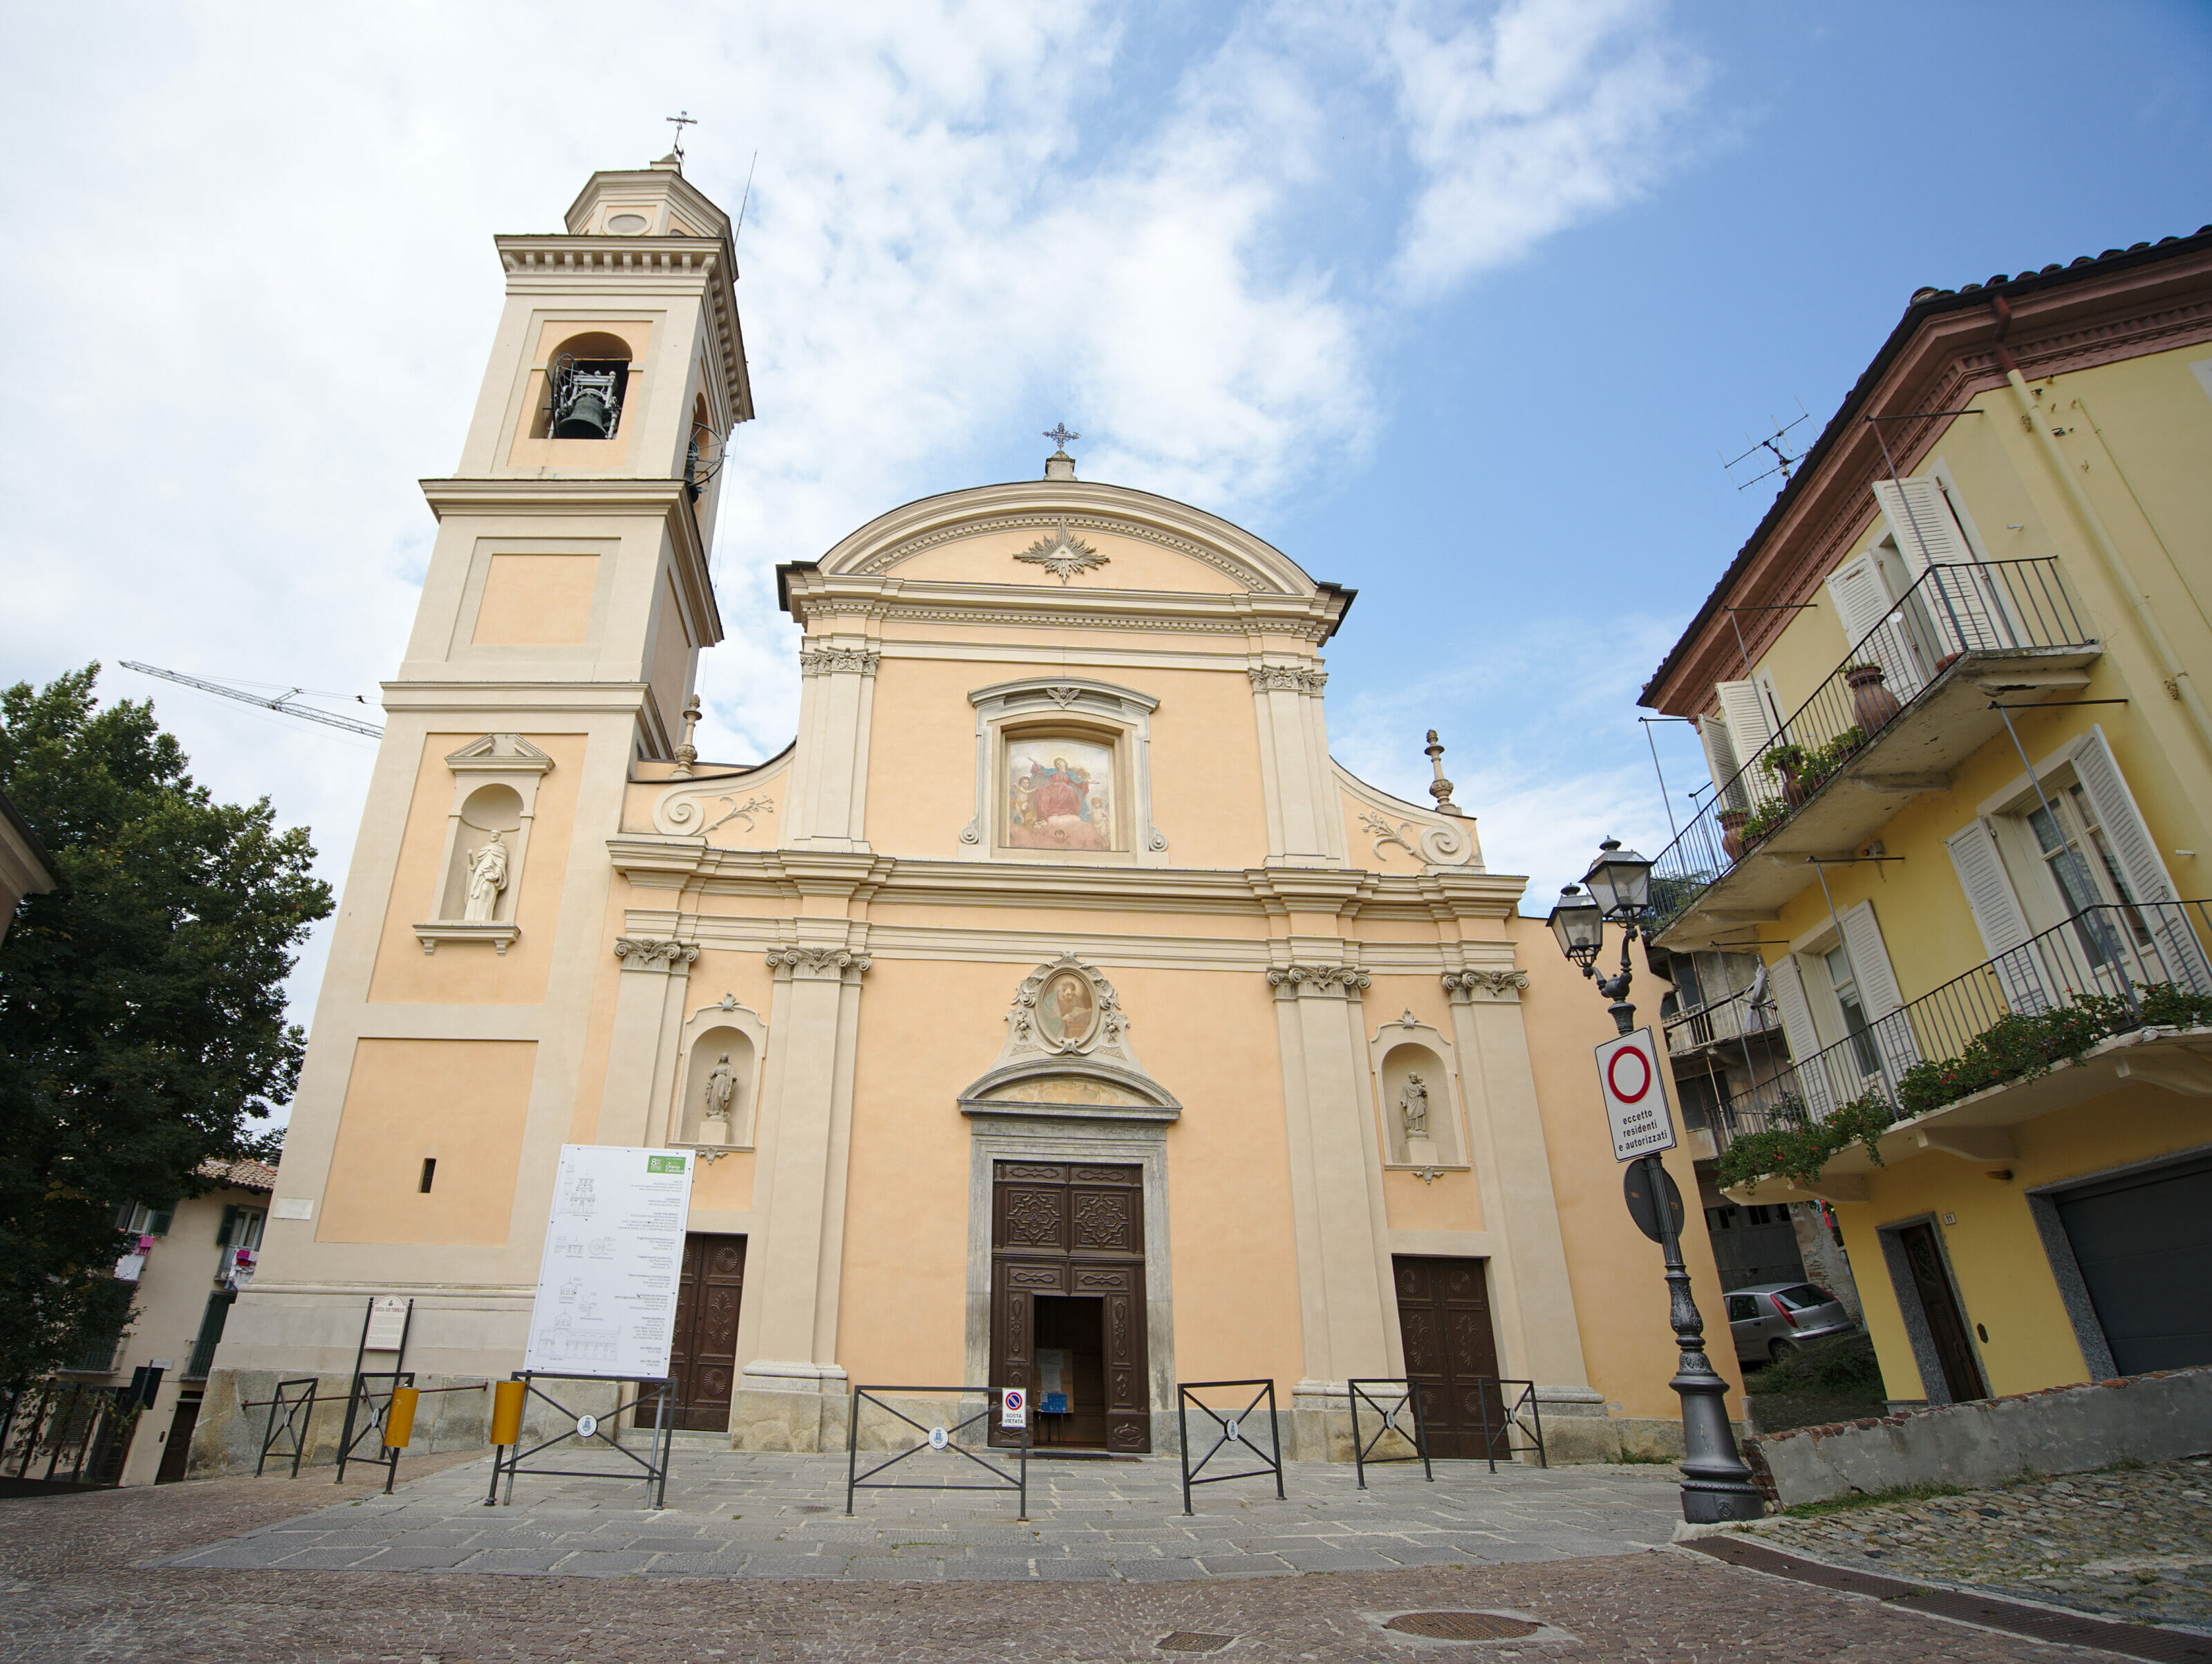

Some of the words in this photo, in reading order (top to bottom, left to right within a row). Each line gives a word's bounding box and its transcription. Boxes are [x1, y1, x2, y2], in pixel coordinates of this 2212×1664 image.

[1622, 1110, 1652, 1125] eccetto
[1623, 1119, 1657, 1138] residenti
[1626, 1130, 1667, 1150] autorizzati
